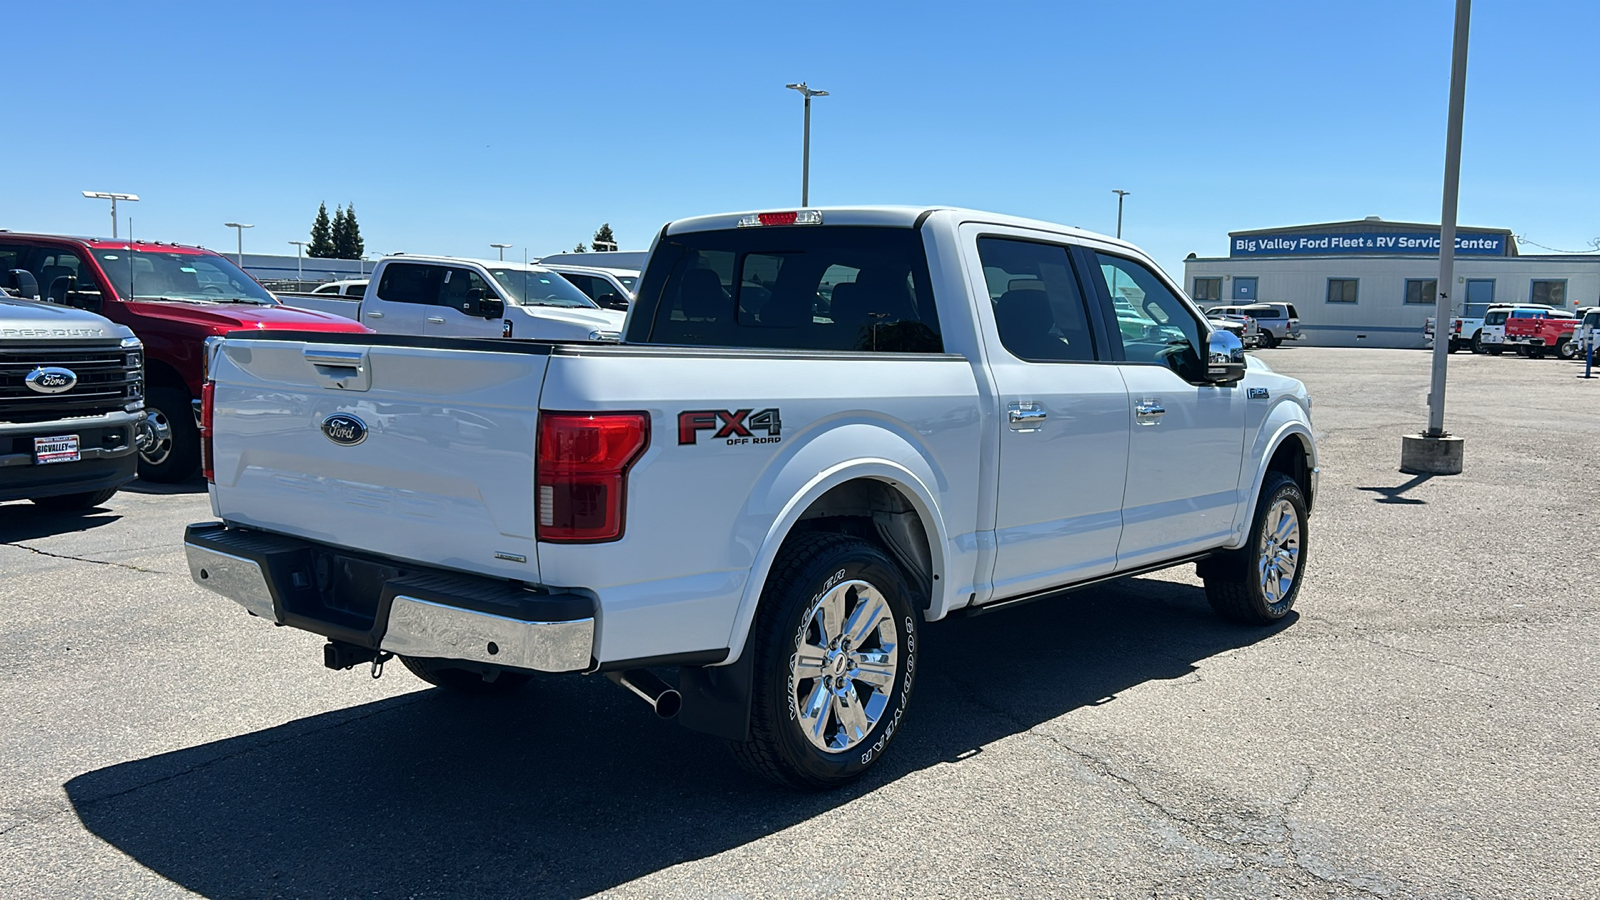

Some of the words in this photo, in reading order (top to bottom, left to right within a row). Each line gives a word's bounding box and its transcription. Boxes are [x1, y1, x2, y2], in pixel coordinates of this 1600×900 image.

[1236, 239, 1256, 251] Big
[1259, 239, 1297, 250] Valley
[1300, 238, 1328, 249] Ford
[1331, 237, 1364, 248] Fleet
[1366, 239, 1375, 247] &
[1376, 237, 1396, 247] RV
[1398, 237, 1440, 248] Servic
[42, 374, 66, 385] Ford
[329, 419, 354, 438] Ford
[677, 408, 782, 446] FX4
[726, 438, 749, 446] OFF
[752, 437, 782, 445] ROAD
[861, 616, 914, 765] GOODYEAR
